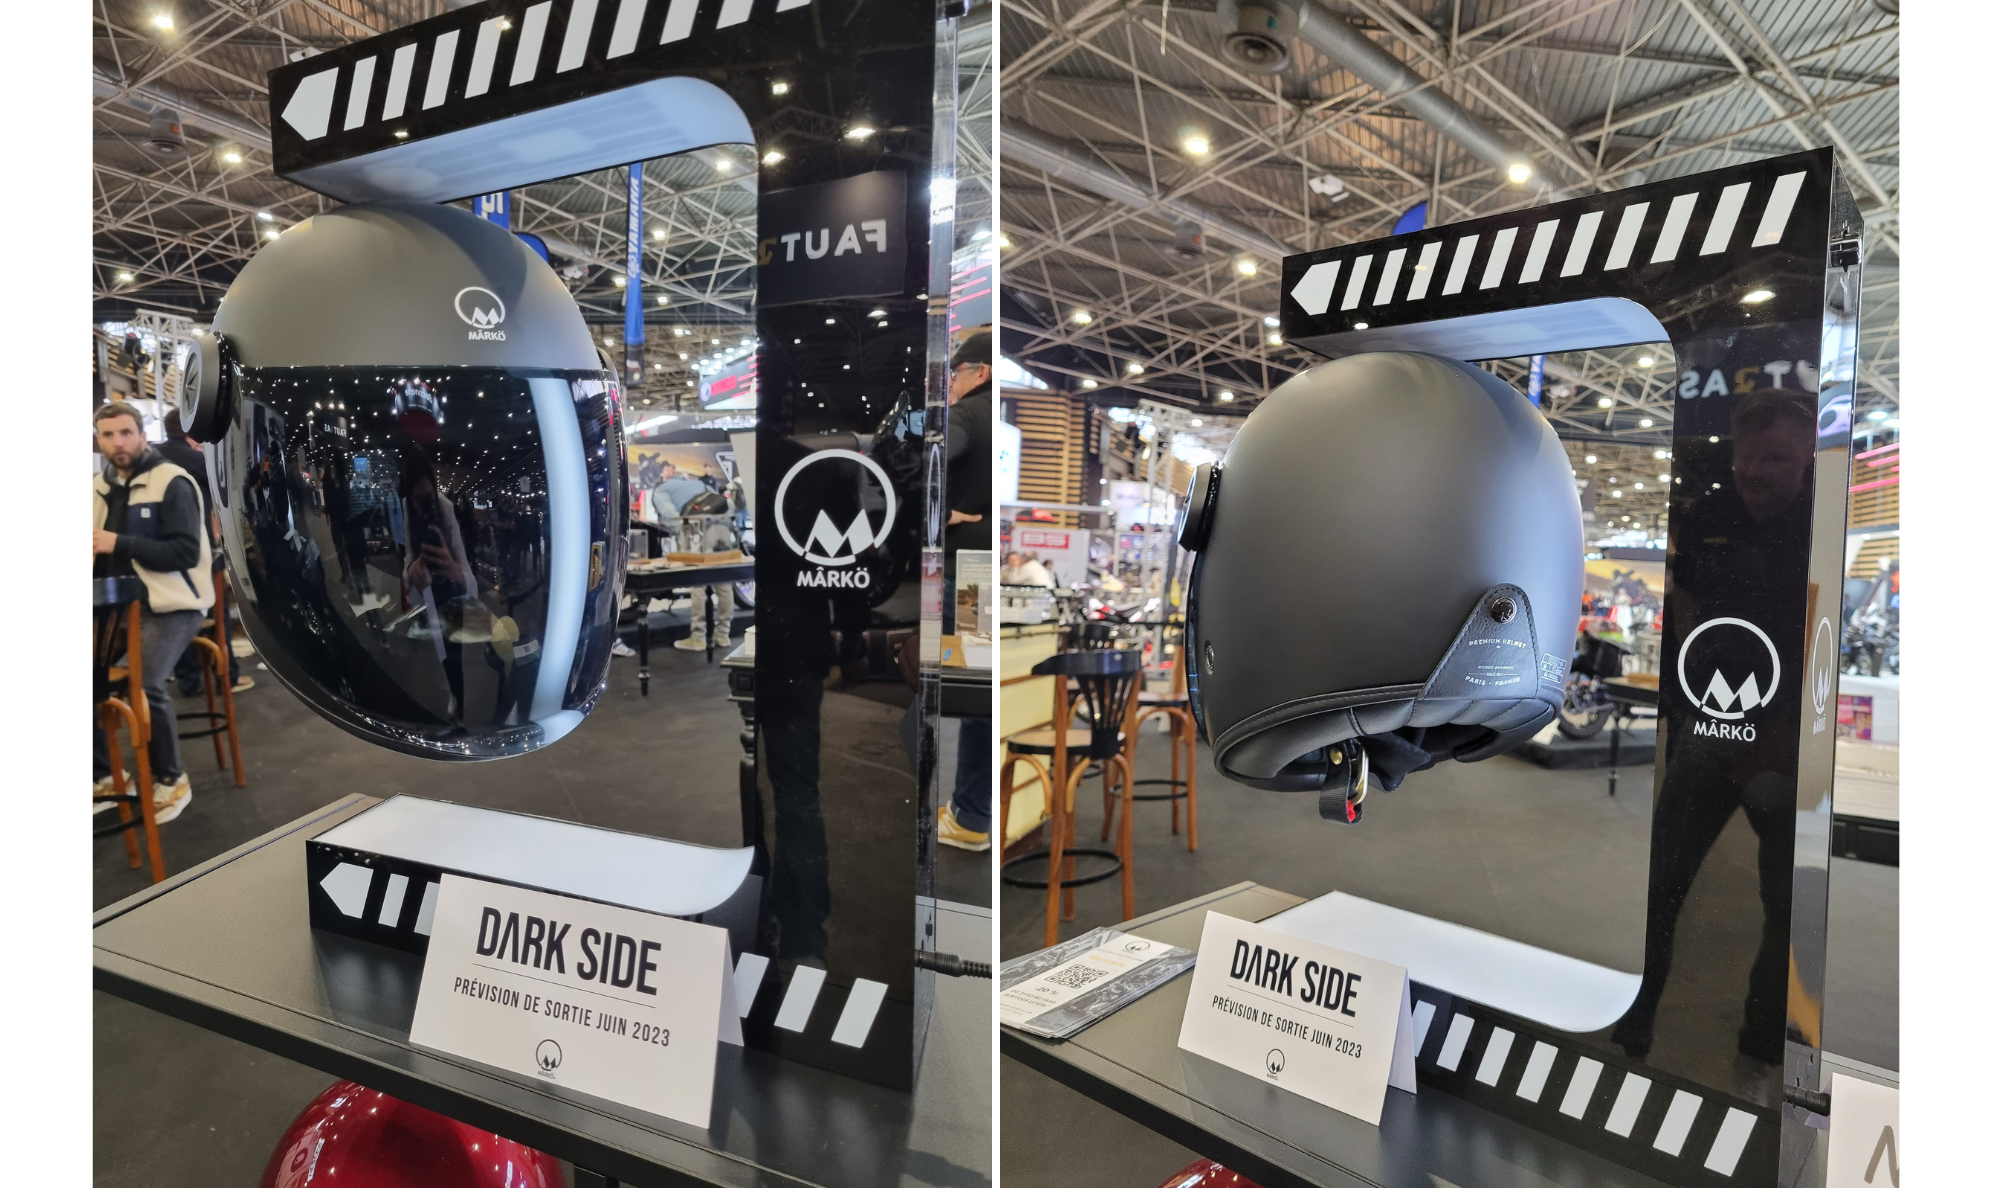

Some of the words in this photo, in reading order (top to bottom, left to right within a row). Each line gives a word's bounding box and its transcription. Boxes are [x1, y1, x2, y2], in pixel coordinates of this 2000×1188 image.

[468, 329, 506, 341] MÂRKÖ
[797, 566, 870, 588] MÂRKÖ
[1469, 638, 1501, 646] PREMIUM
[1502, 639, 1527, 649] HELMET
[1465, 675, 1486, 686] PARIS
[1693, 719, 1756, 742] MÂRKÖ
[476, 906, 572, 974] DARK
[576, 927, 662, 996] SIDE
[1230, 938, 1300, 997] DARK
[1300, 960, 1362, 1018] SIDE
[453, 976, 520, 1008] PRÉVISION
[523, 994, 541, 1014] DE
[544, 999, 592, 1027] SORTIE
[596, 1012, 627, 1036] JUIN
[632, 1022, 671, 1047] 2023
[1212, 995, 1259, 1022] PRÉVISION
[1260, 1011, 1274, 1028] DE
[1275, 1016, 1310, 1040] SORTIE
[1310, 1028, 1333, 1049] JUIN
[1335, 1037, 1362, 1059] 2023
